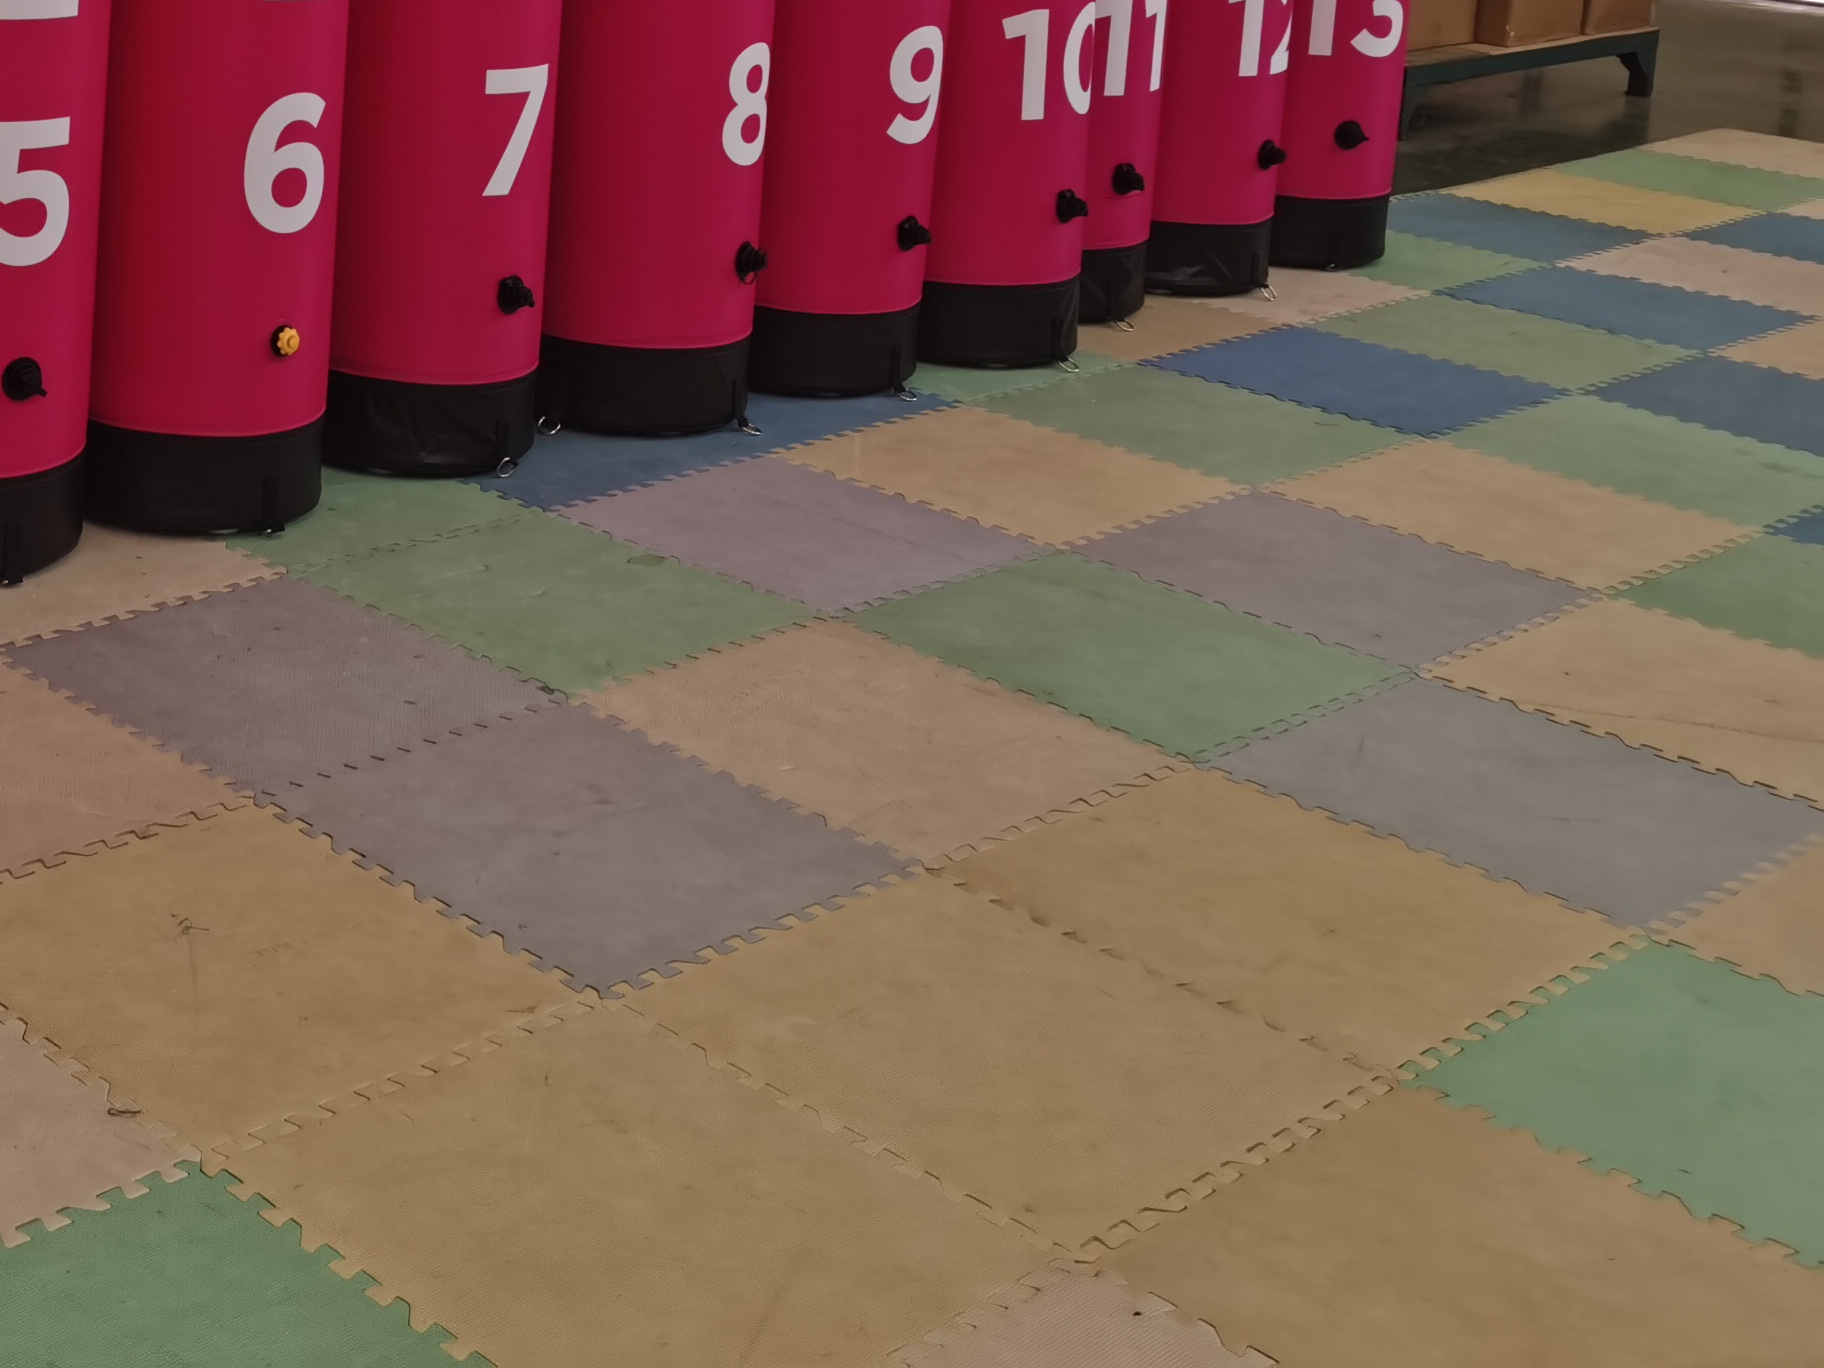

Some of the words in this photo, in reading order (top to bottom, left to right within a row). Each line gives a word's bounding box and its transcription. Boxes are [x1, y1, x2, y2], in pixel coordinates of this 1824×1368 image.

[723, 43, 770, 166] 8
[887, 26, 943, 144] 9
[1002, 1, 1095, 120] 10
[244, 93, 326, 233] 6
[483, 65, 550, 201] 7
